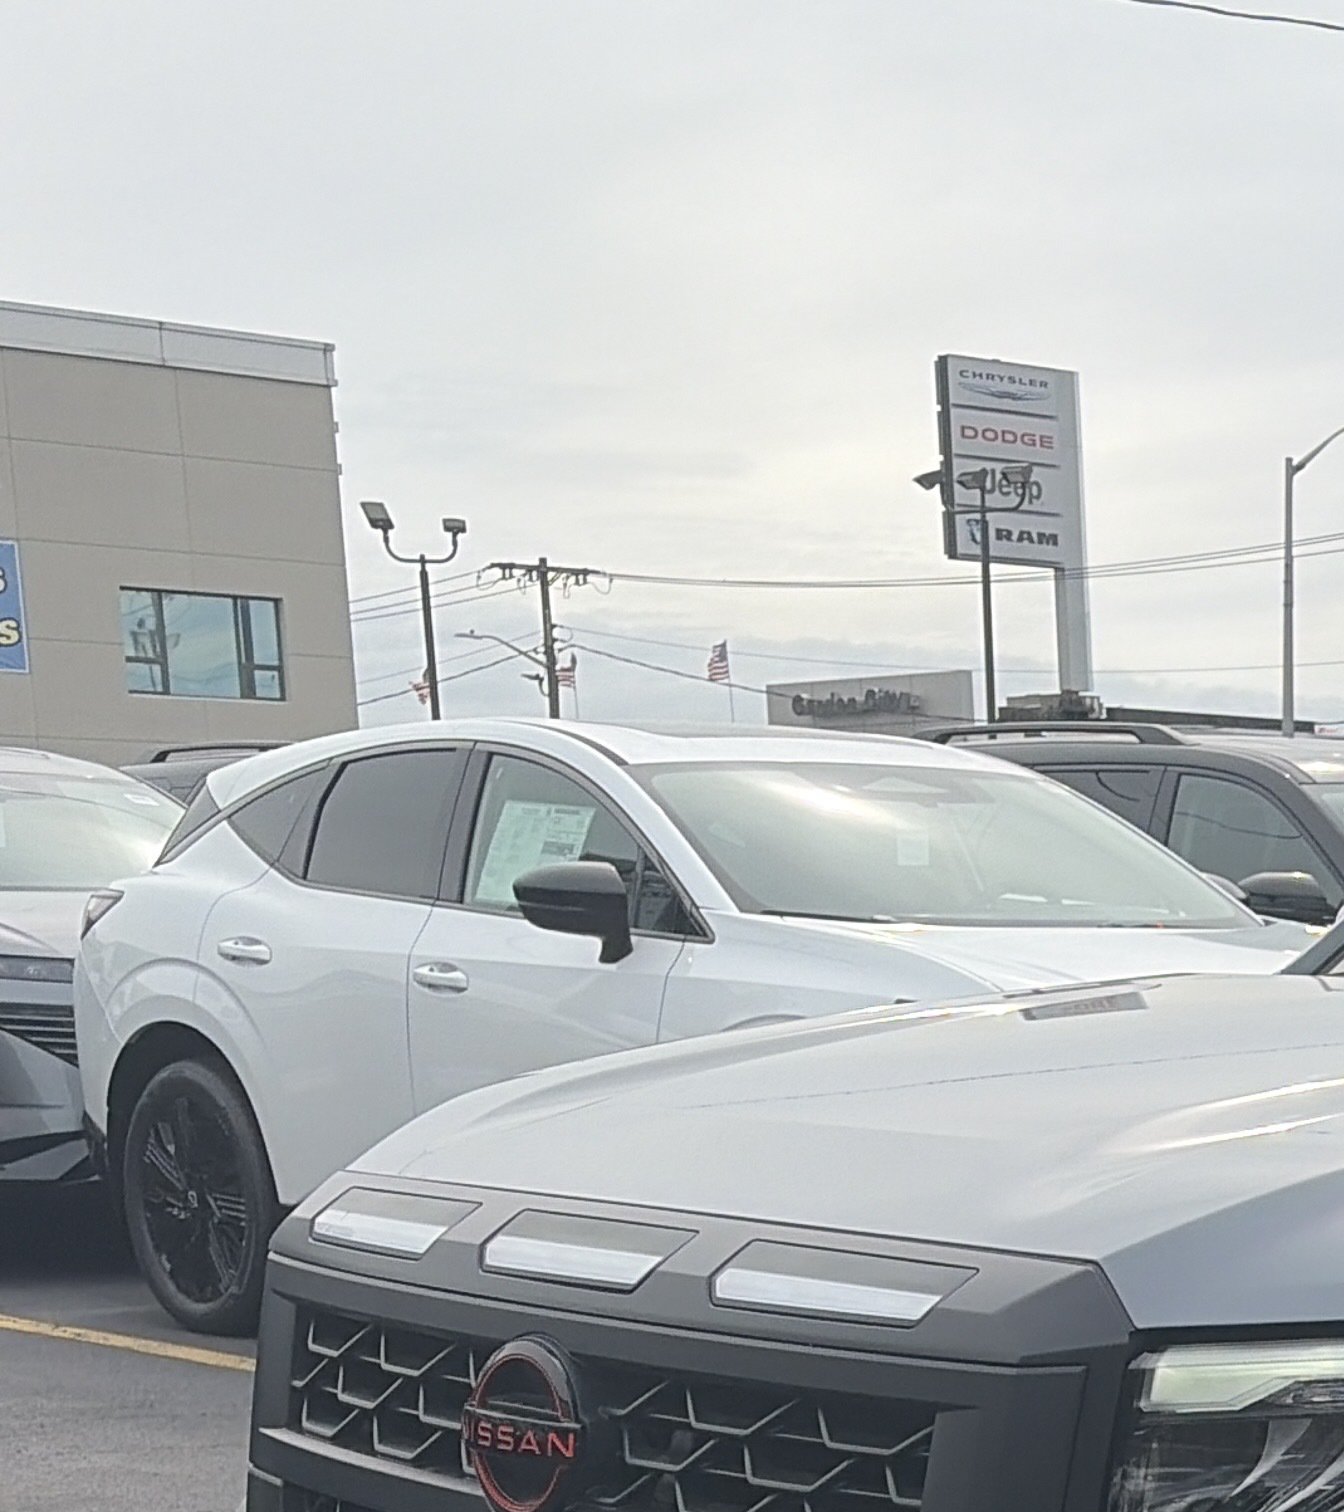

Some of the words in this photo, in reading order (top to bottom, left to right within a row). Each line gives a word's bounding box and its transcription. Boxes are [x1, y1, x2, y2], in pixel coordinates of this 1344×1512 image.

[958, 369, 1049, 389] CHRYSLER
[960, 425, 1054, 449] DODGE
[995, 528, 1059, 547] RAM
[461, 1415, 576, 1458] NISSAN
